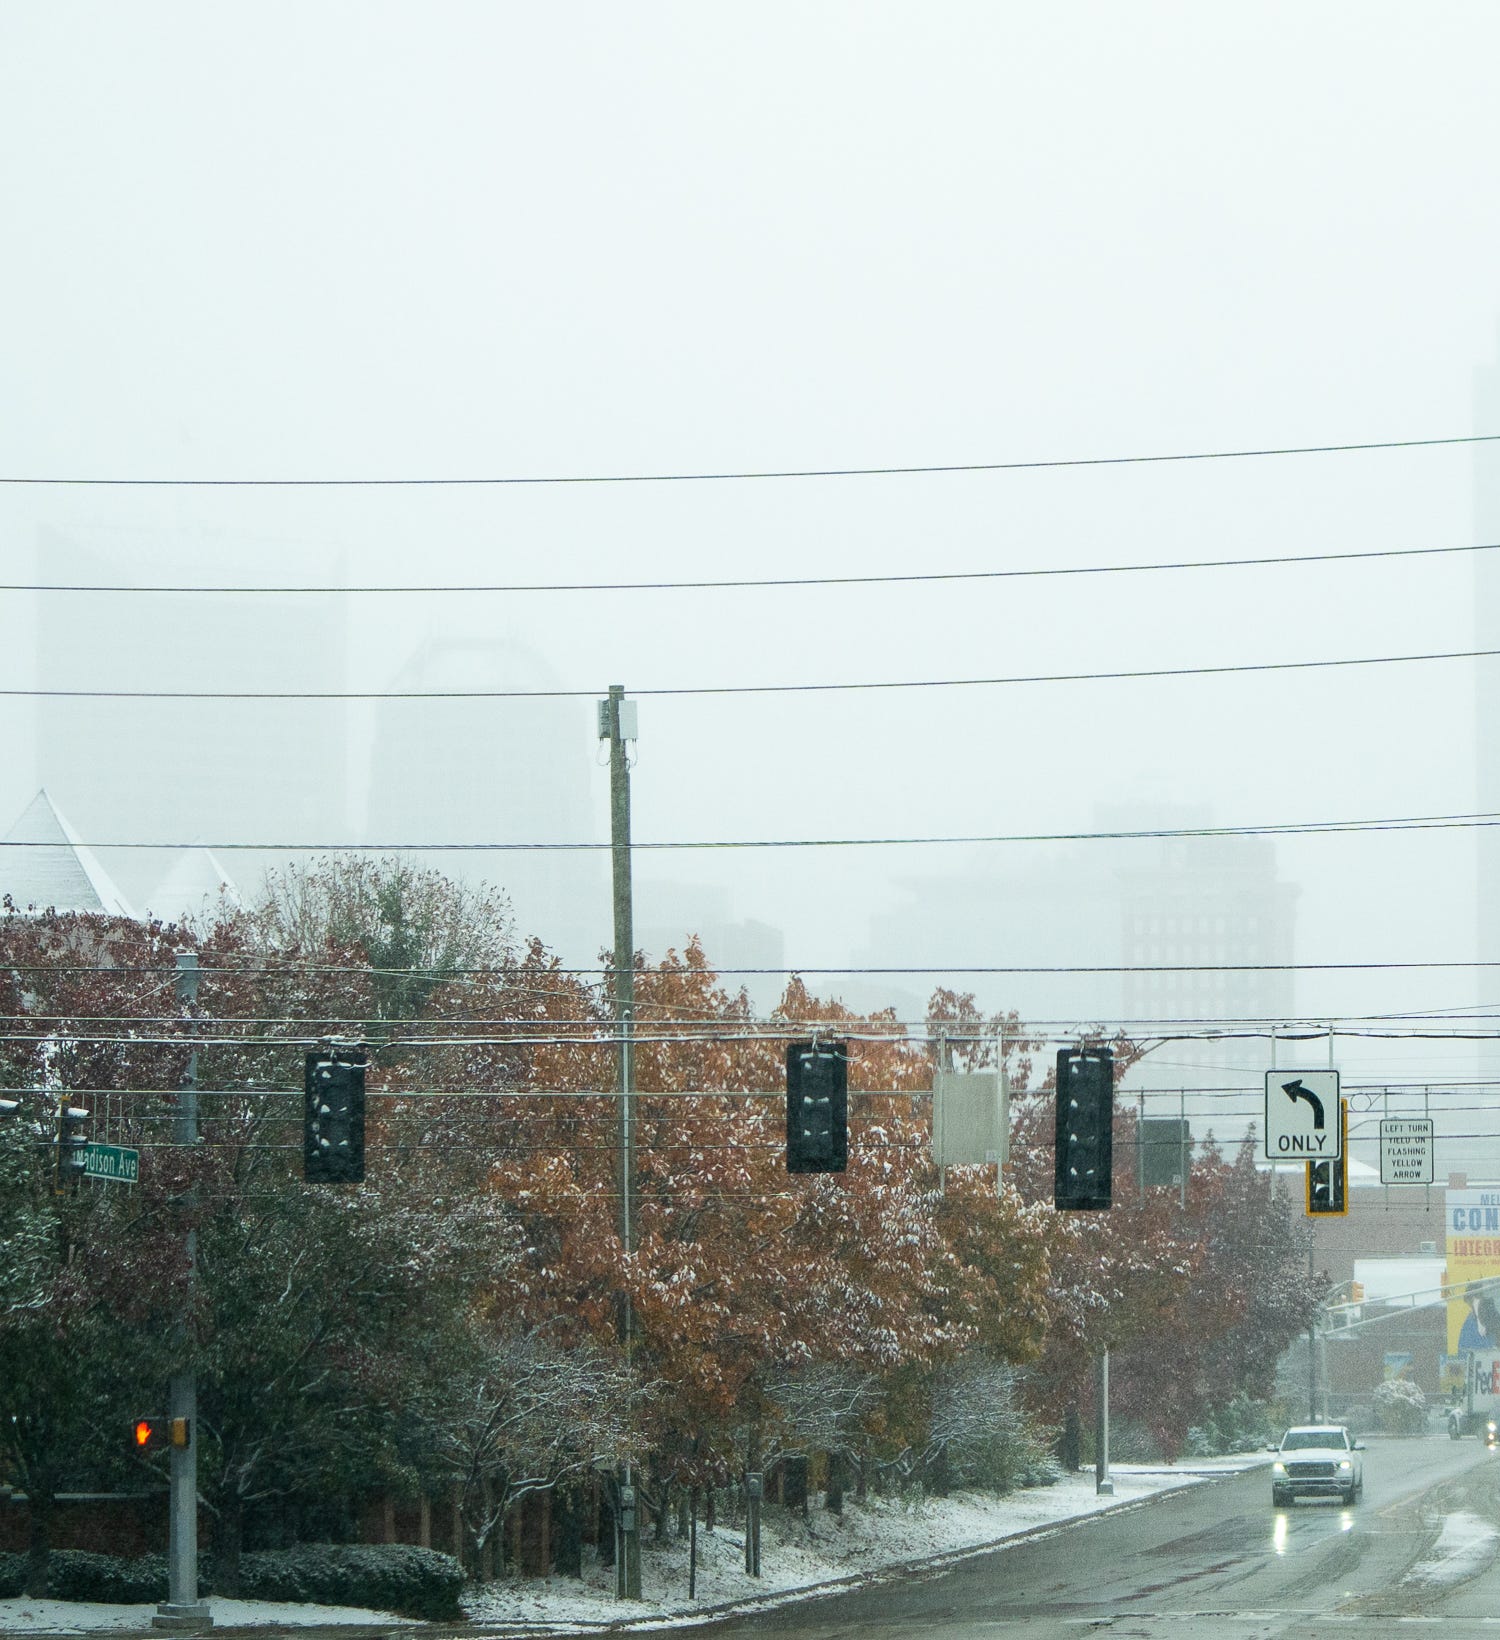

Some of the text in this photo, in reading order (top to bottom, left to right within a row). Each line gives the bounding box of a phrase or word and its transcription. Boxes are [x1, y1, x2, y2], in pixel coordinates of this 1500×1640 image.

[1385, 1124, 1428, 1132] LEFT TURN
[1278, 1135, 1327, 1151] ONLY
[1388, 1136, 1426, 1144] YIELD ON
[1388, 1148, 1426, 1156] FLASHING
[119, 1152, 136, 1177] Ave
[1392, 1159, 1422, 1167] YELLOW
